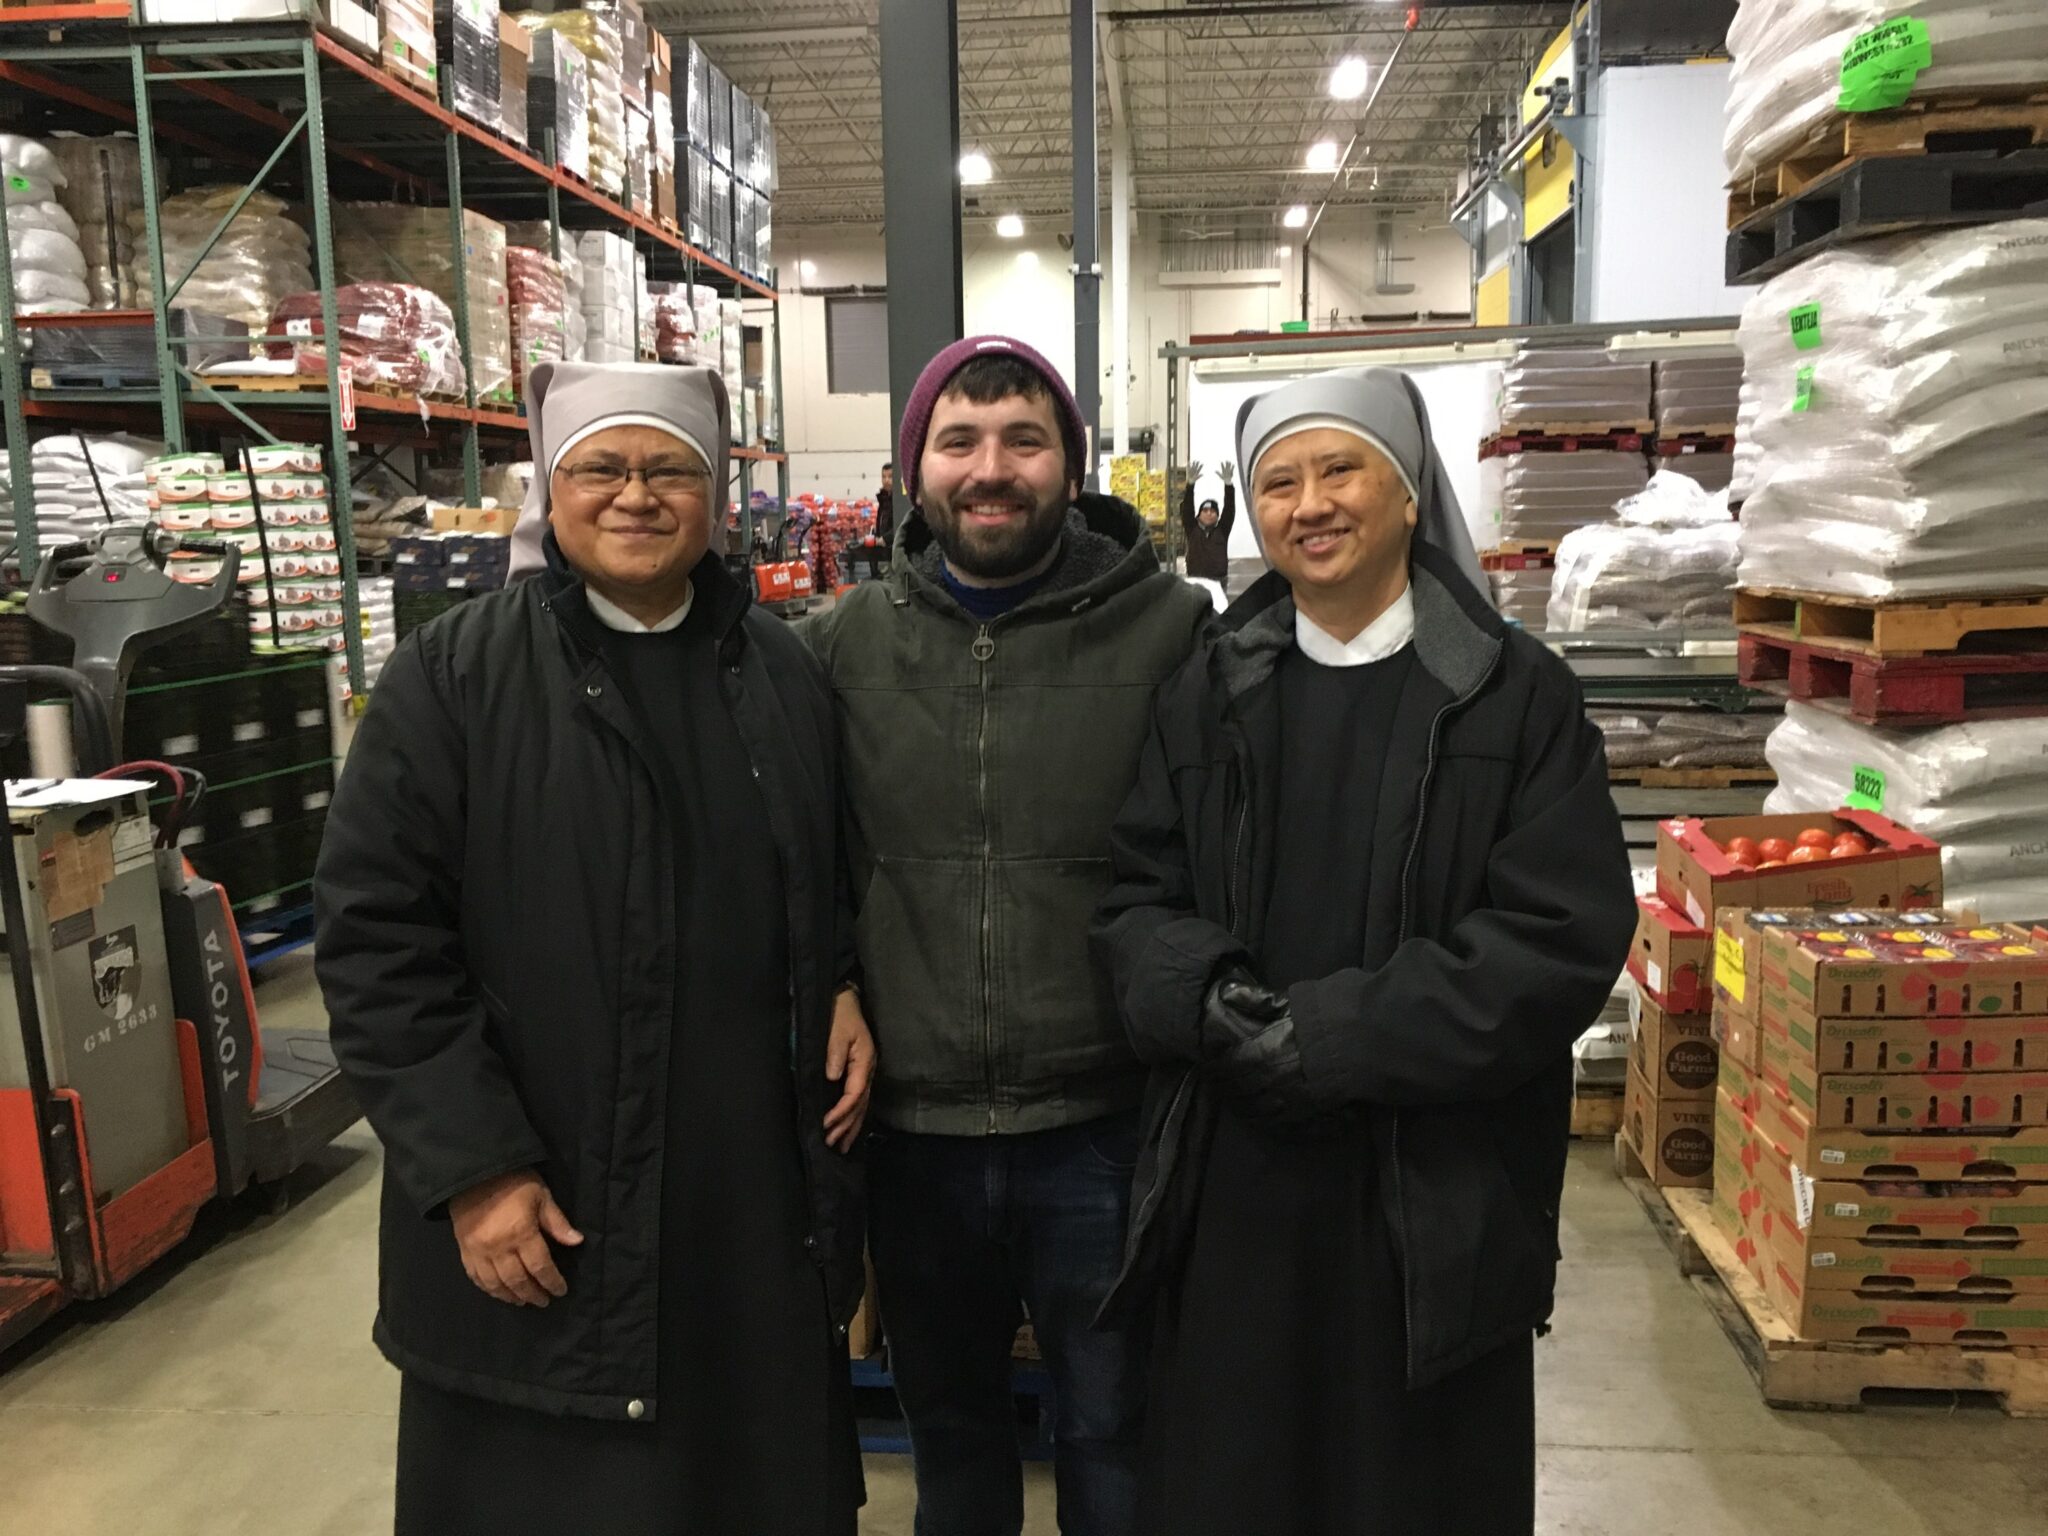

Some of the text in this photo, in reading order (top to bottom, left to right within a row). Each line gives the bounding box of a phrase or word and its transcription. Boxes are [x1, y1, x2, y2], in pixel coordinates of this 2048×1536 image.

[1855, 772, 1882, 800] 58223
[204, 929, 239, 1092] TOYOTA
[83, 1026, 111, 1053] GM
[1675, 1050, 1711, 1063] Good
[1673, 1113, 1711, 1124] VINE
[1671, 1138, 1706, 1150] Good
